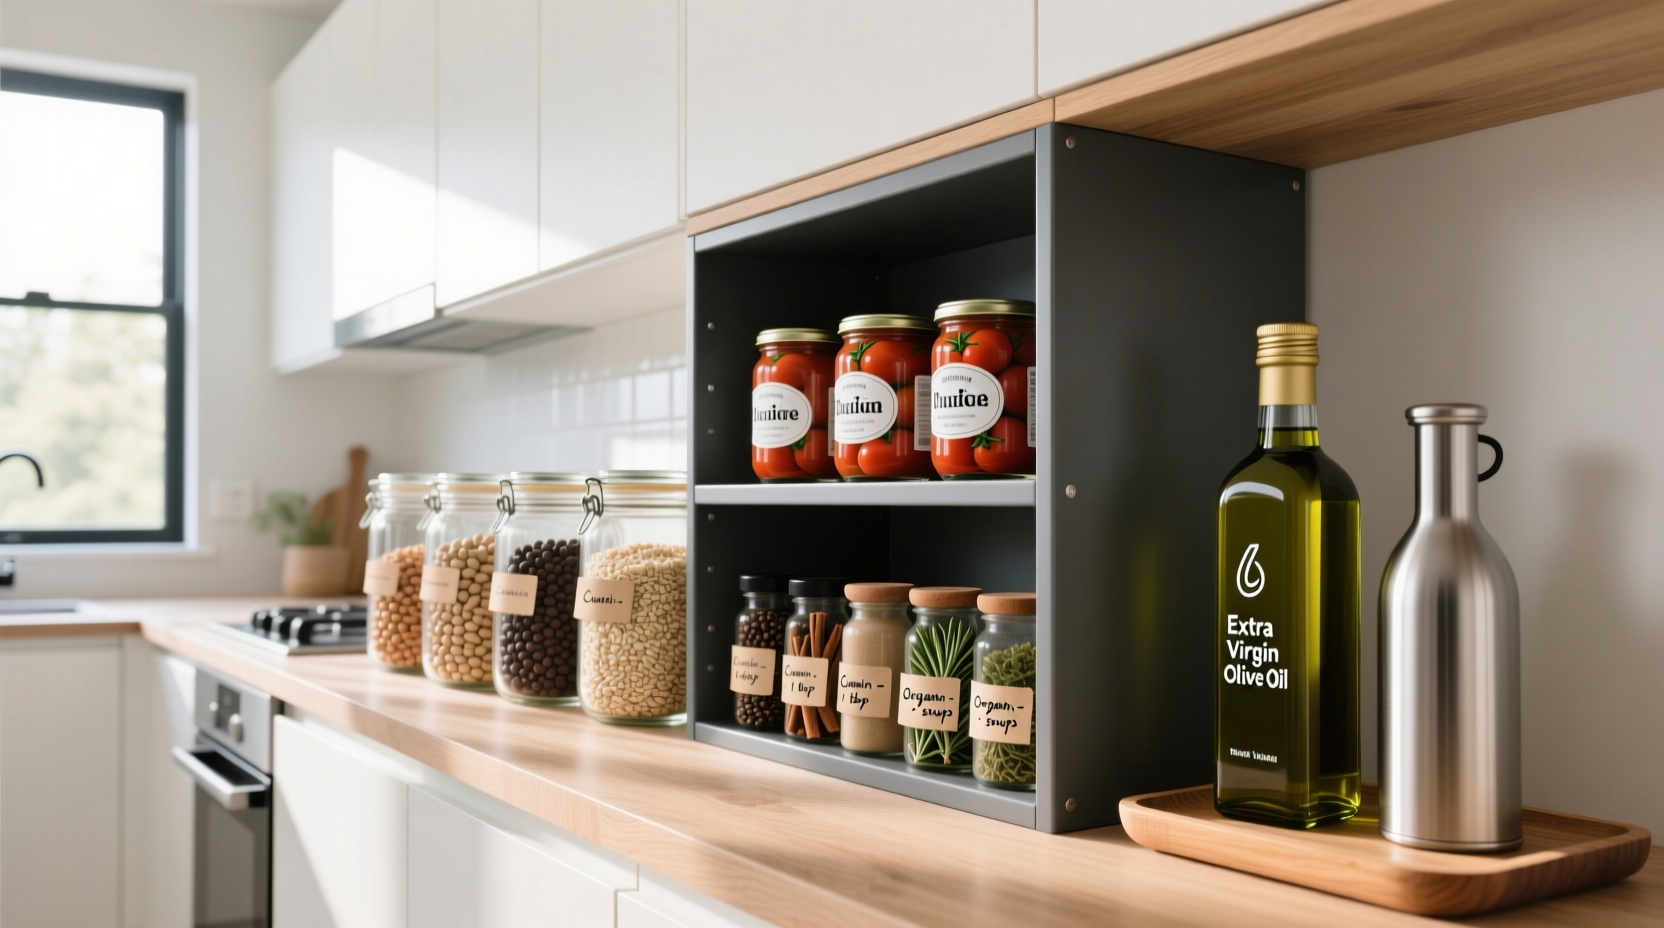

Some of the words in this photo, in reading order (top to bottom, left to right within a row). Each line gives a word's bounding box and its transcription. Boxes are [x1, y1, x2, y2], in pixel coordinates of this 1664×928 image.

[1227, 614, 1273, 637] Extra
[1226, 639, 1279, 668] Virgin
[1224, 664, 1264, 686] Olive
[1266, 668, 1288, 689] Oil
